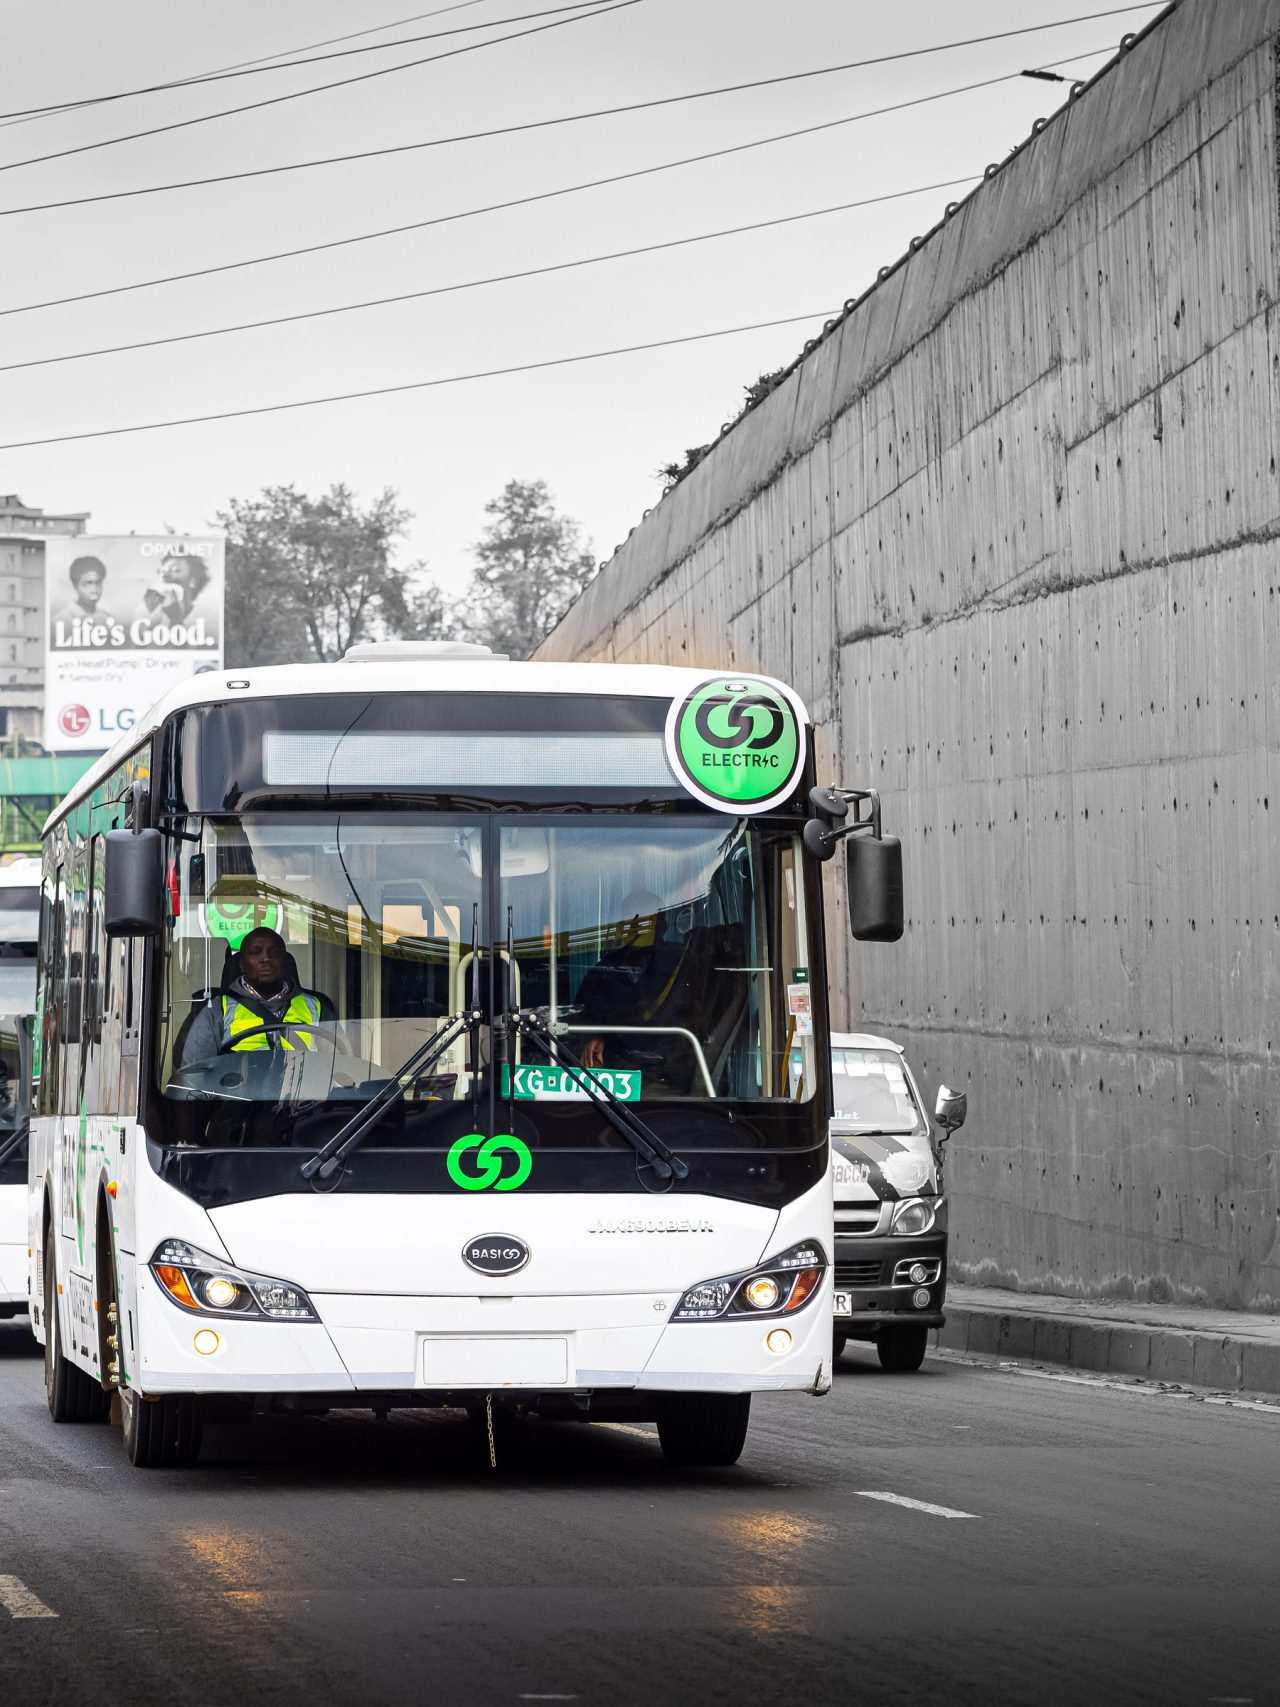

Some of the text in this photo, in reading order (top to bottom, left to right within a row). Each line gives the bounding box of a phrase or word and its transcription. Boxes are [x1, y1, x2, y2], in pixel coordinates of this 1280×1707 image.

[140, 543, 215, 557] OPALNET
[55, 617, 216, 647] Life's Good.
[146, 658, 180, 669] Dryer
[99, 708, 135, 731] LG
[833, 1294, 846, 1311] R
